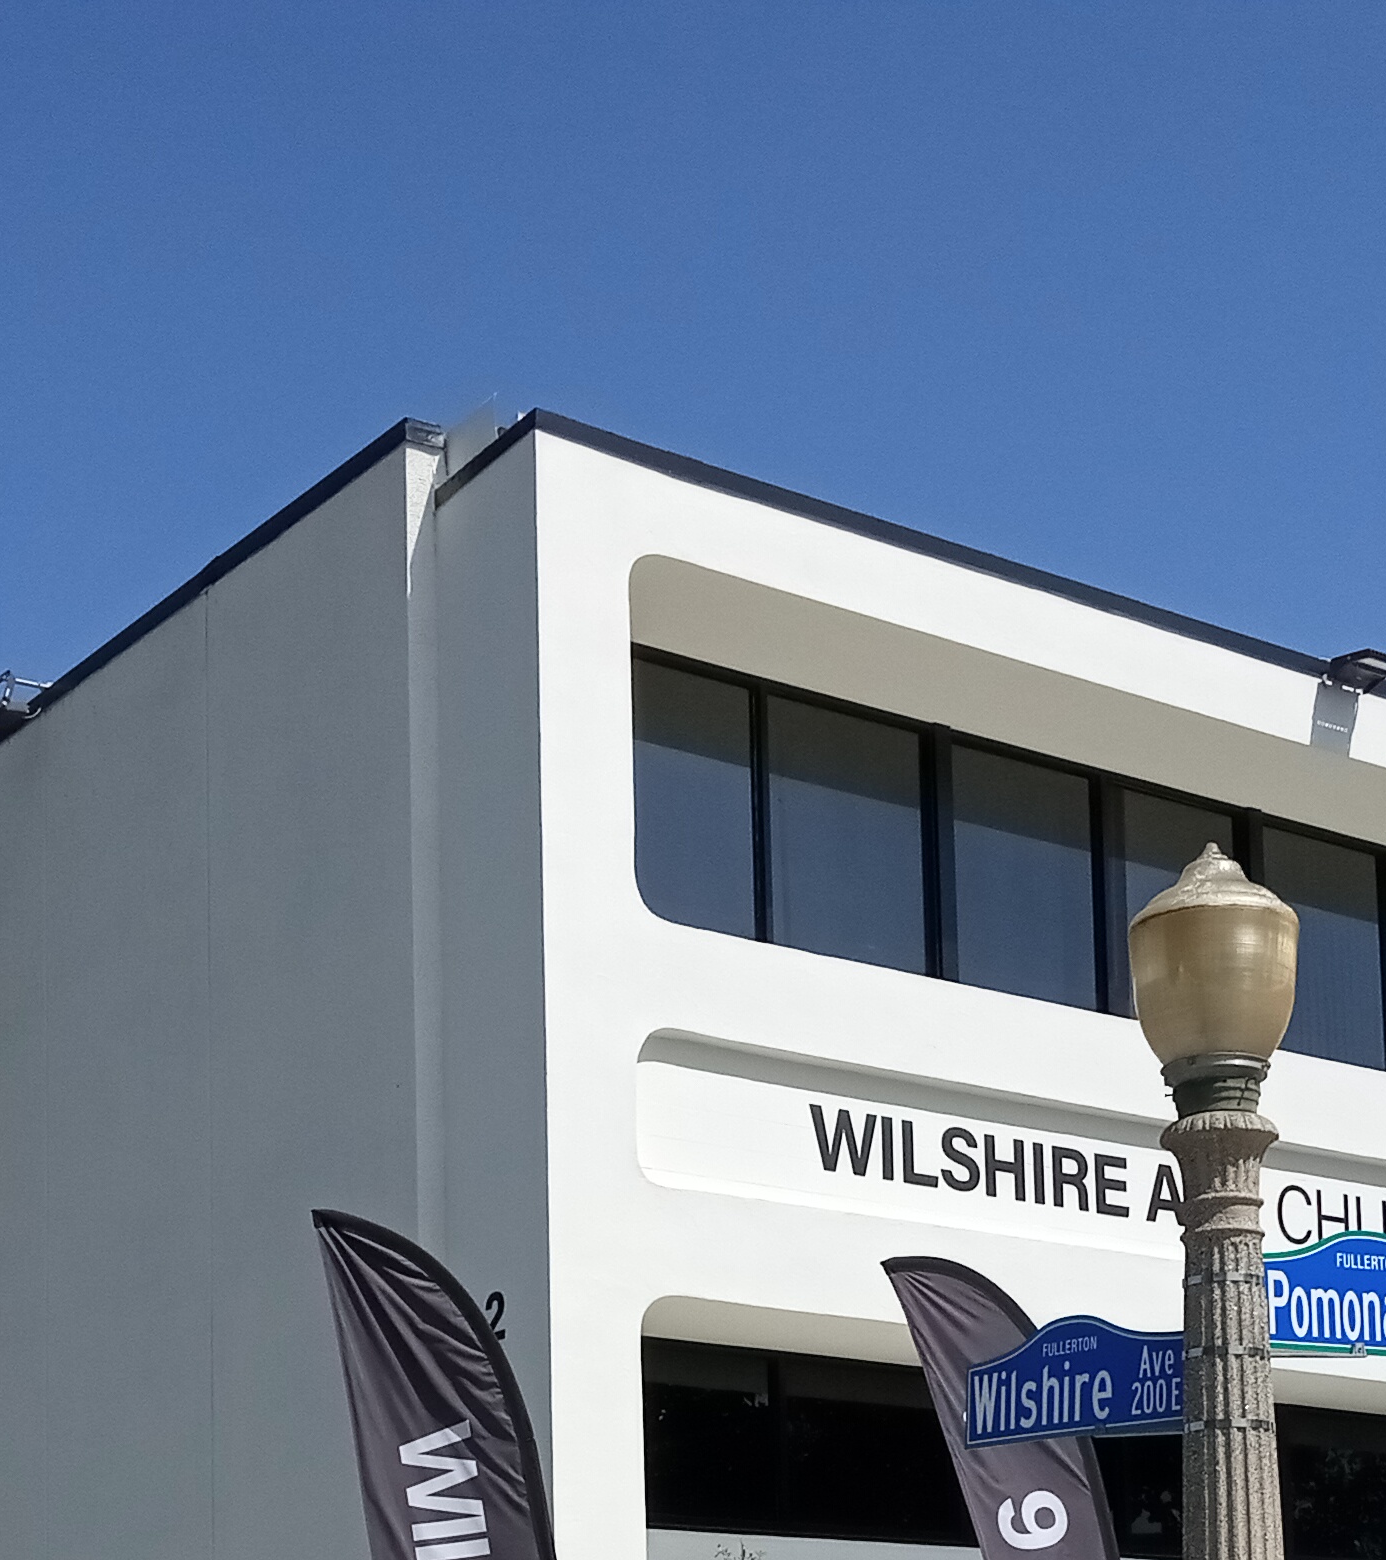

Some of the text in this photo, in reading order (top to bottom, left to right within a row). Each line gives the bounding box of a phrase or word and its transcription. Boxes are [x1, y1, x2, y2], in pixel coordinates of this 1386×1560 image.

[808, 1103, 1131, 1219] WILSHIRE
[1042, 1335, 1098, 1358] FULLERTON
[973, 1345, 1175, 1435] Wilshire Ave
[1130, 1377, 1182, 1417] 200 E
[997, 1489, 1069, 1552] 9
